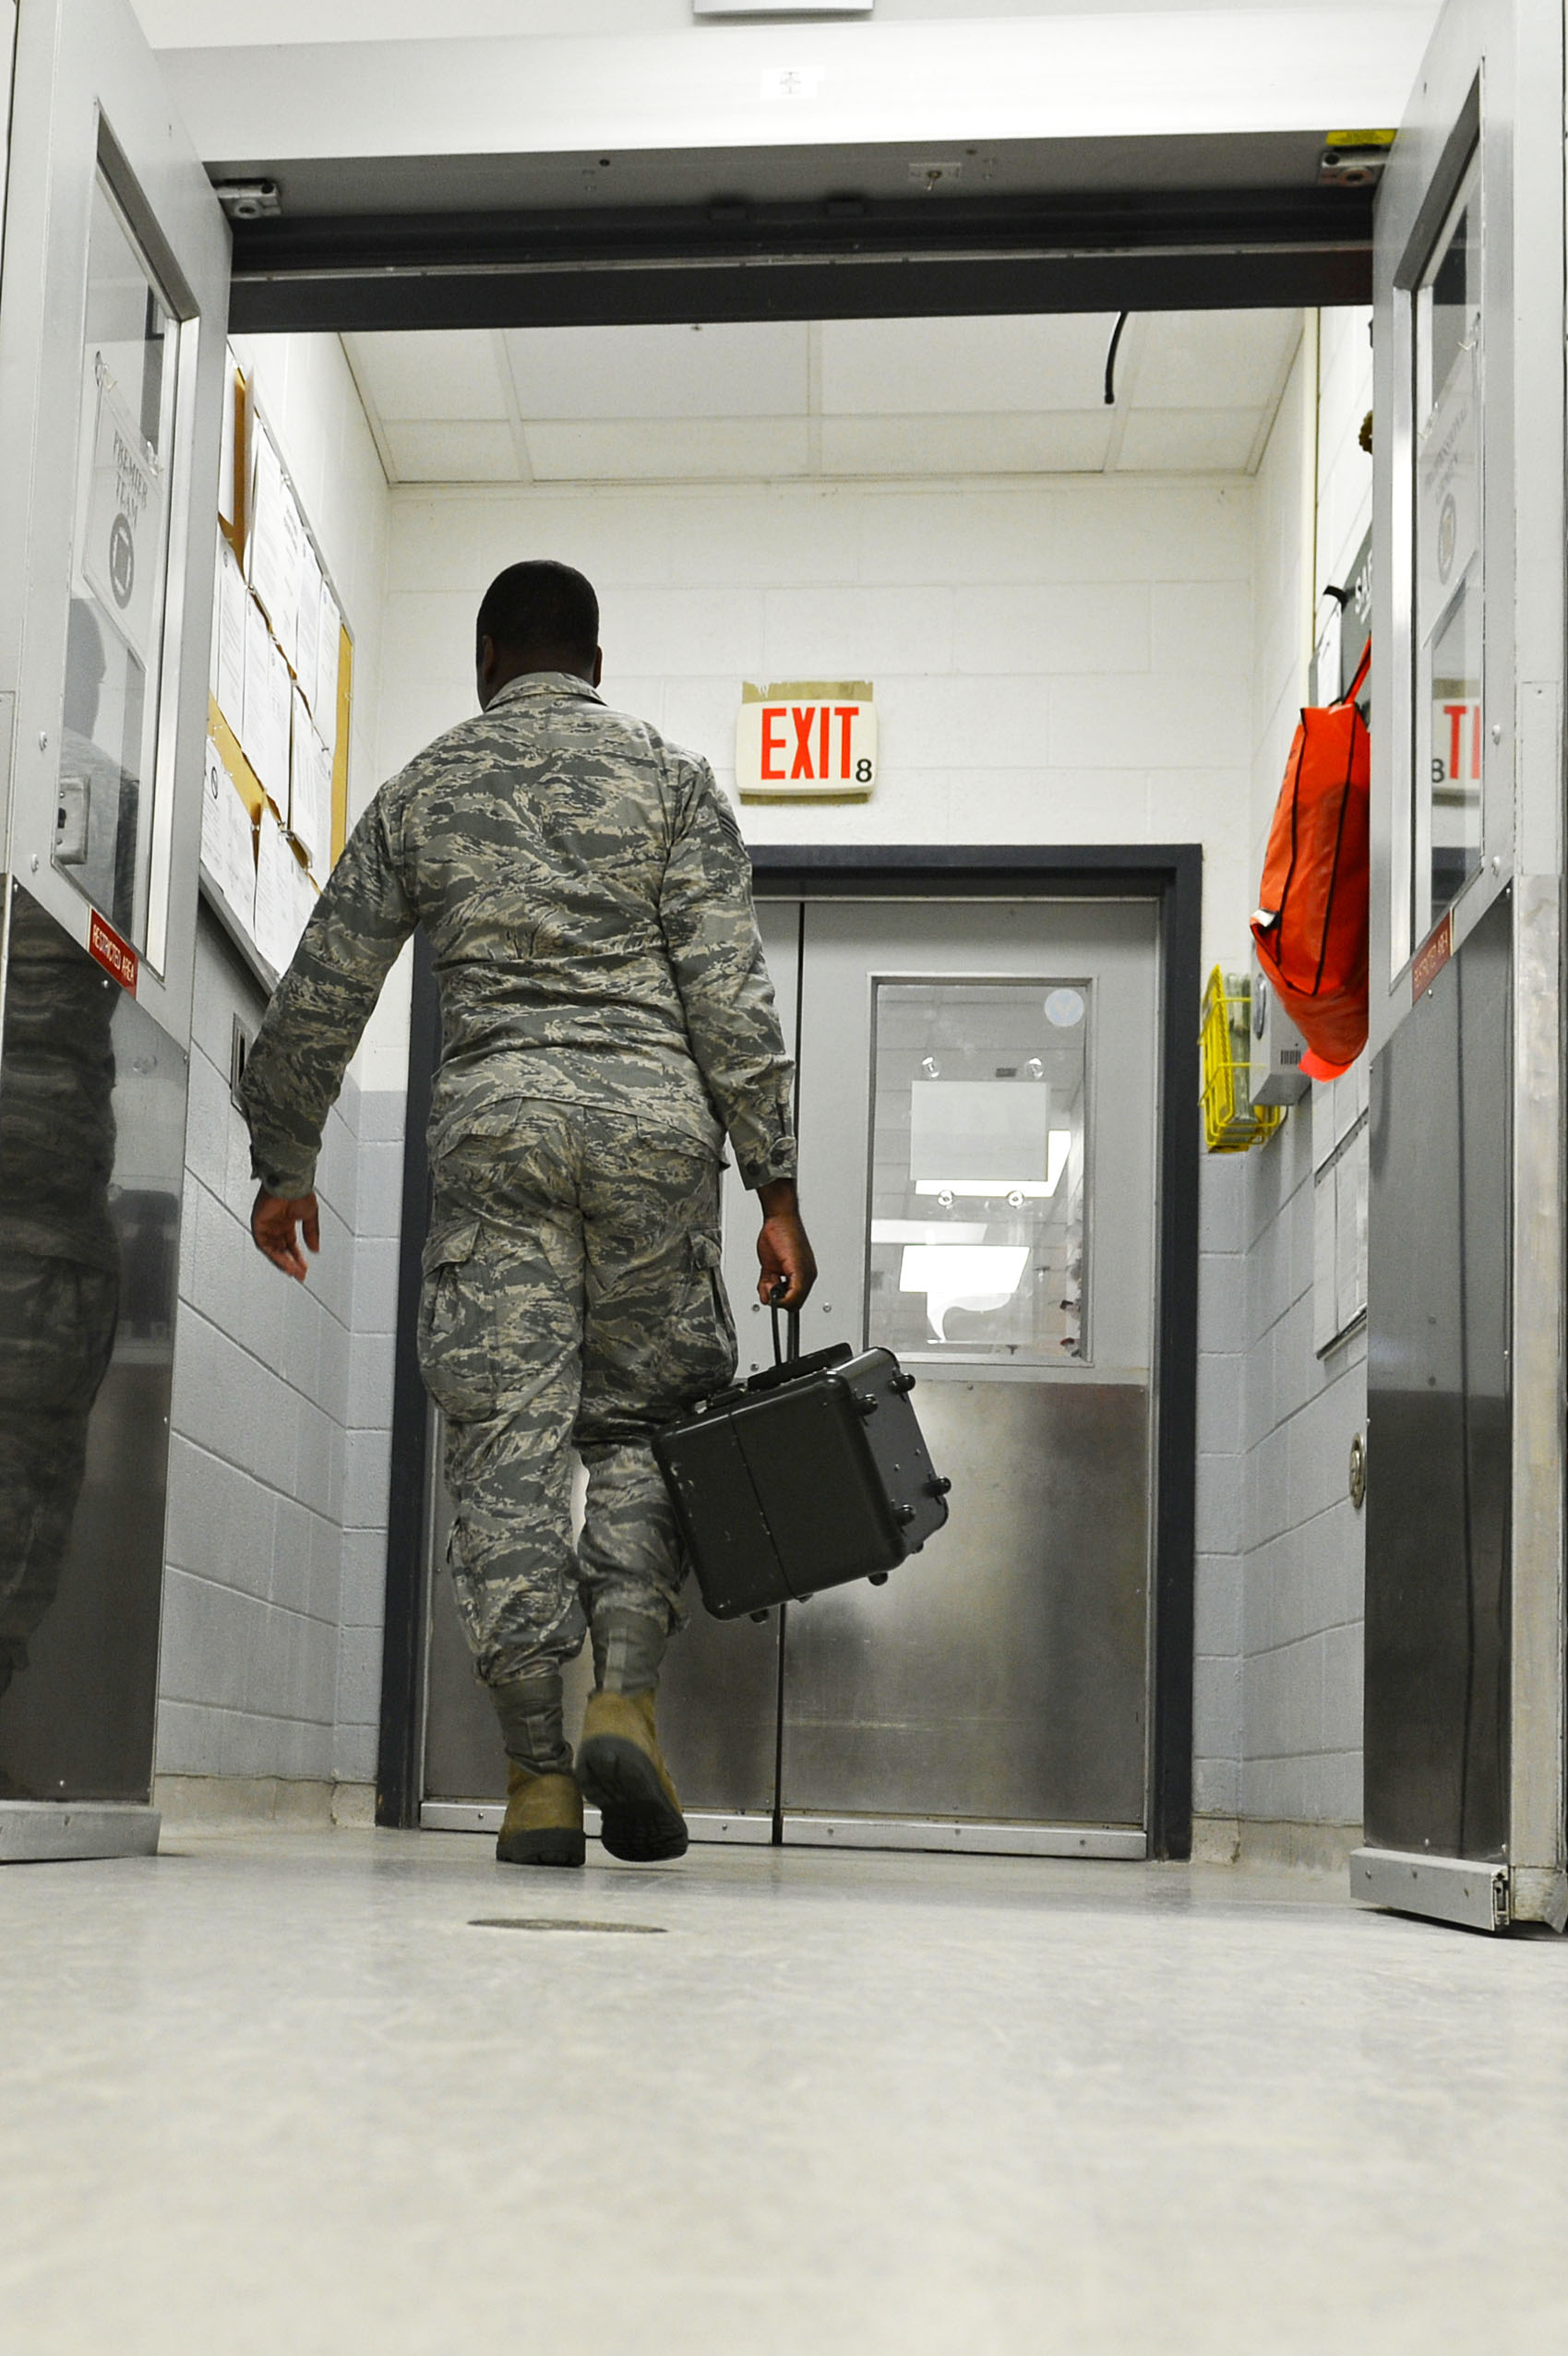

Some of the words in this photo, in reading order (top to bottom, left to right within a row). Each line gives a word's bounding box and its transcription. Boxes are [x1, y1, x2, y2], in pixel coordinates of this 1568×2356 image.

[116, 471, 138, 531] TEAM
[761, 707, 859, 780] EXIT
[856, 758, 872, 783] 8
[92, 924, 121, 971] RESTRICTED
[122, 955, 135, 985] AREA
